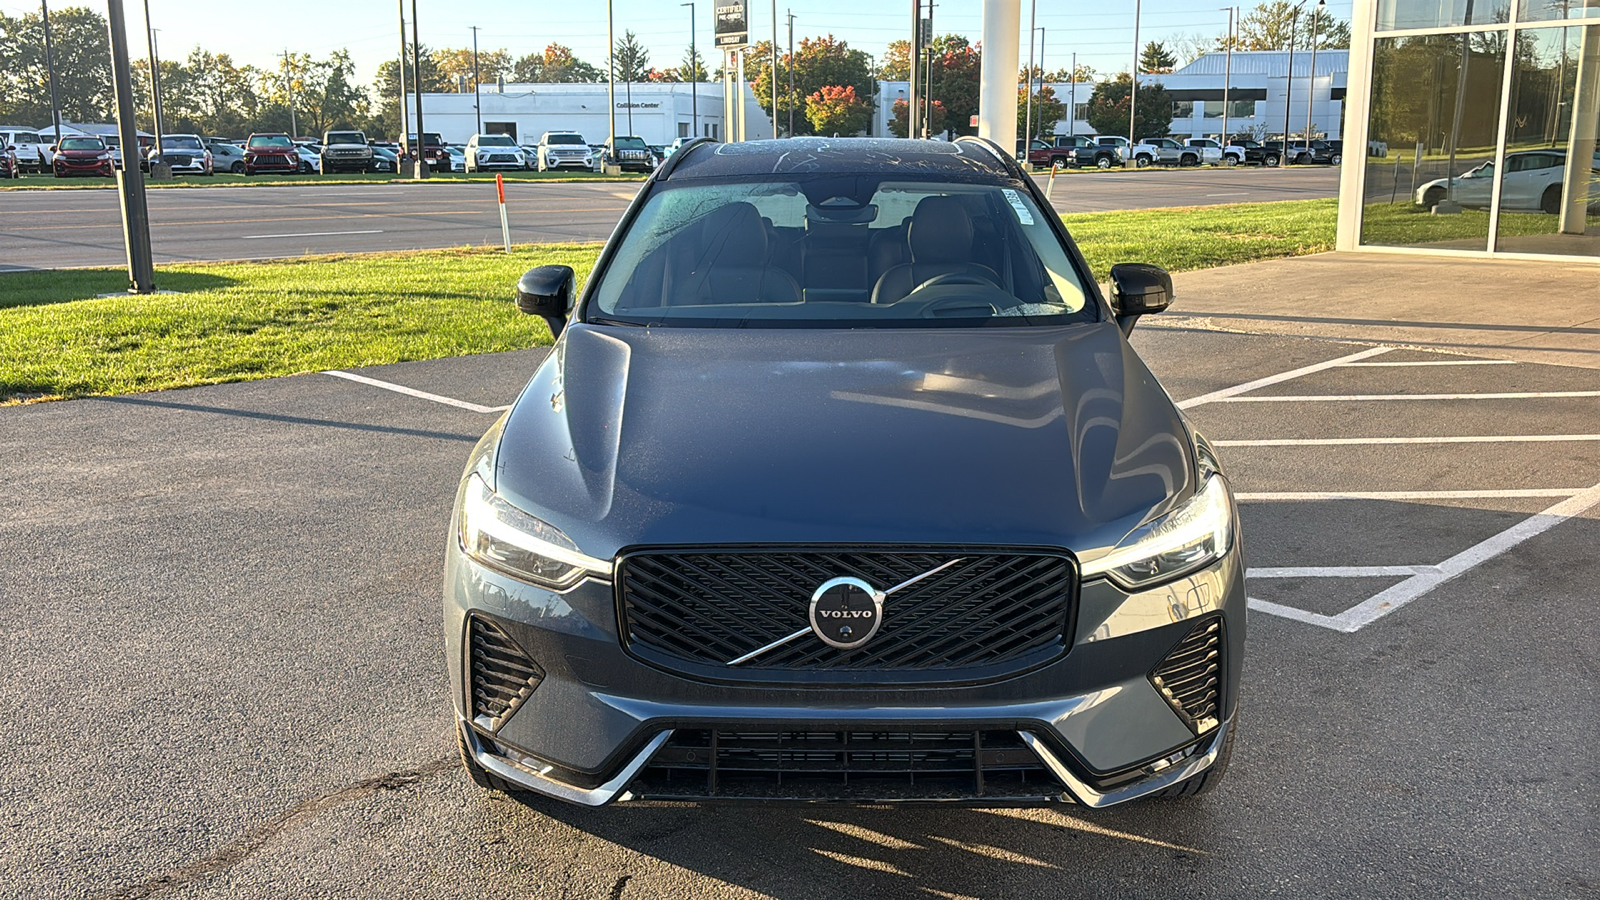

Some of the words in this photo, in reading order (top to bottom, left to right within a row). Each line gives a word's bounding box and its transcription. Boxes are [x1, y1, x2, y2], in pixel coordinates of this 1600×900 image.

[716, 5, 743, 14] CERTIFIED
[720, 36, 740, 44] LINDSAY
[819, 610, 872, 618] VOLVO
